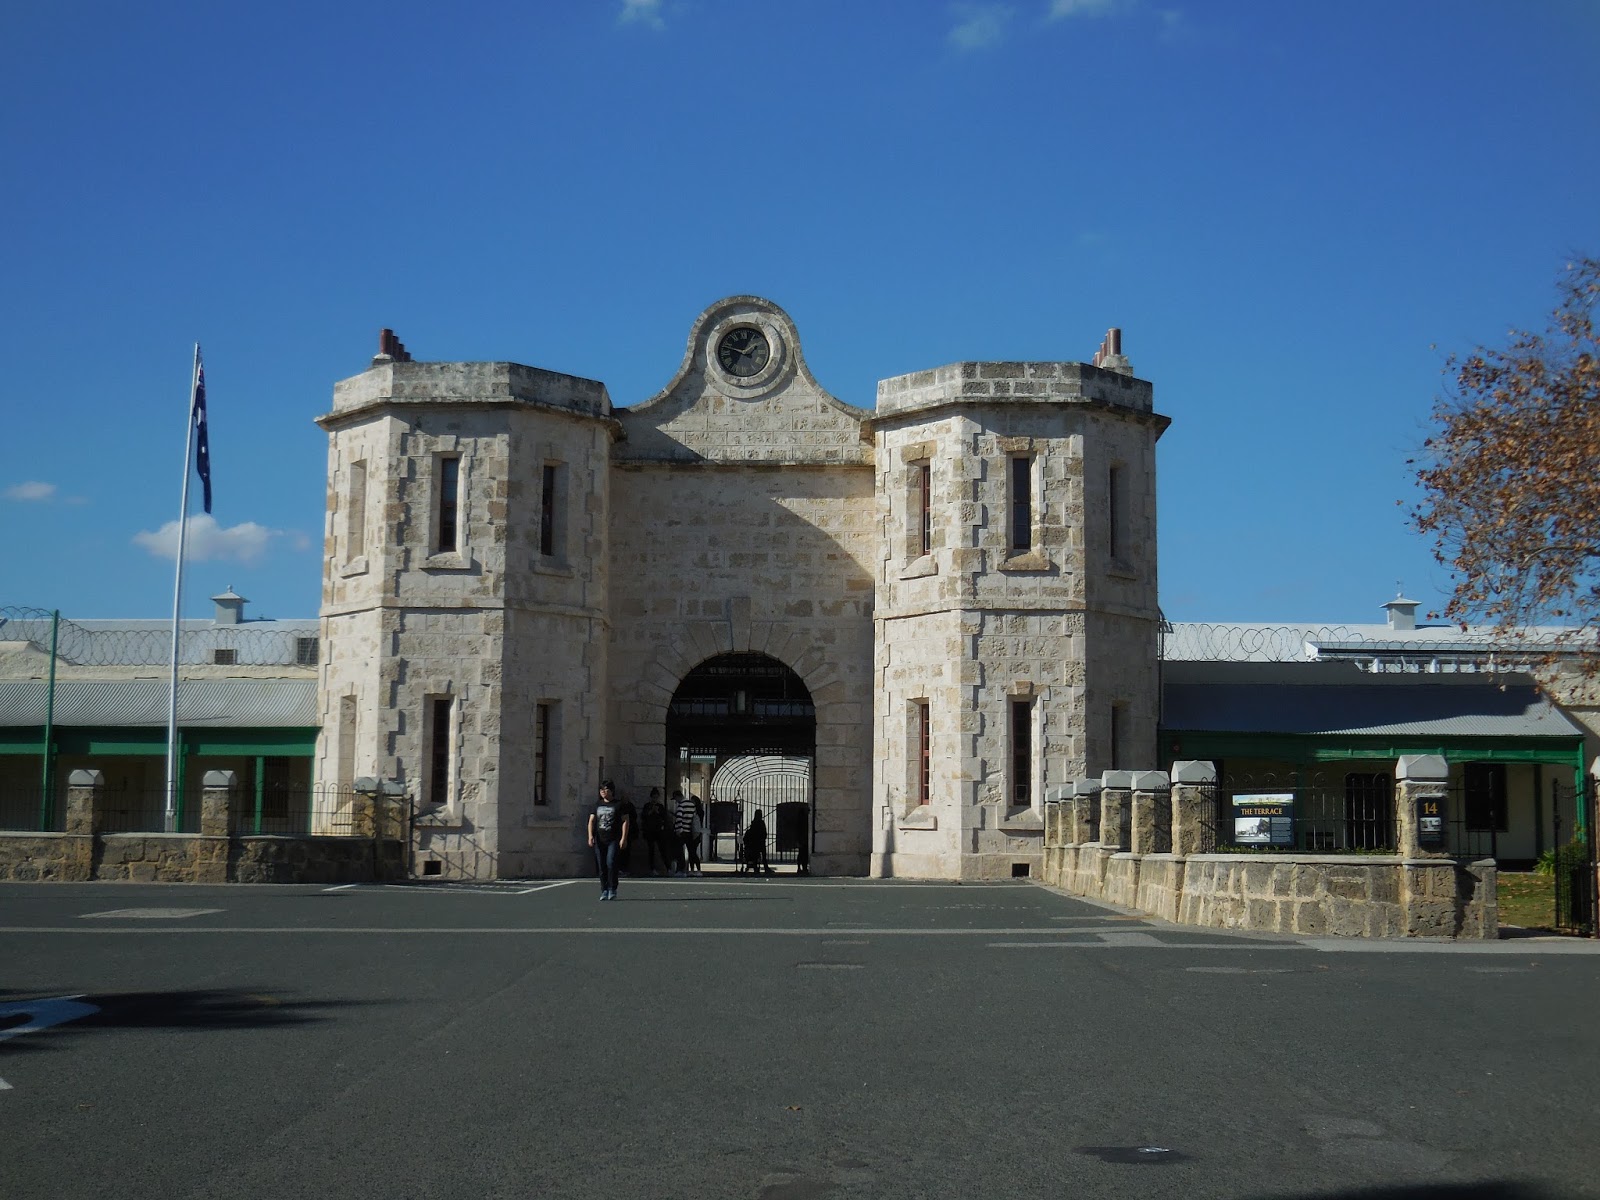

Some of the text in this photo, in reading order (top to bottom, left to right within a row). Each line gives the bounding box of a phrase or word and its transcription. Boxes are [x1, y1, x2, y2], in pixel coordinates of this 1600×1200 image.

[1241, 807, 1283, 816] THE TERRACE
[1424, 802, 1438, 815] 14
